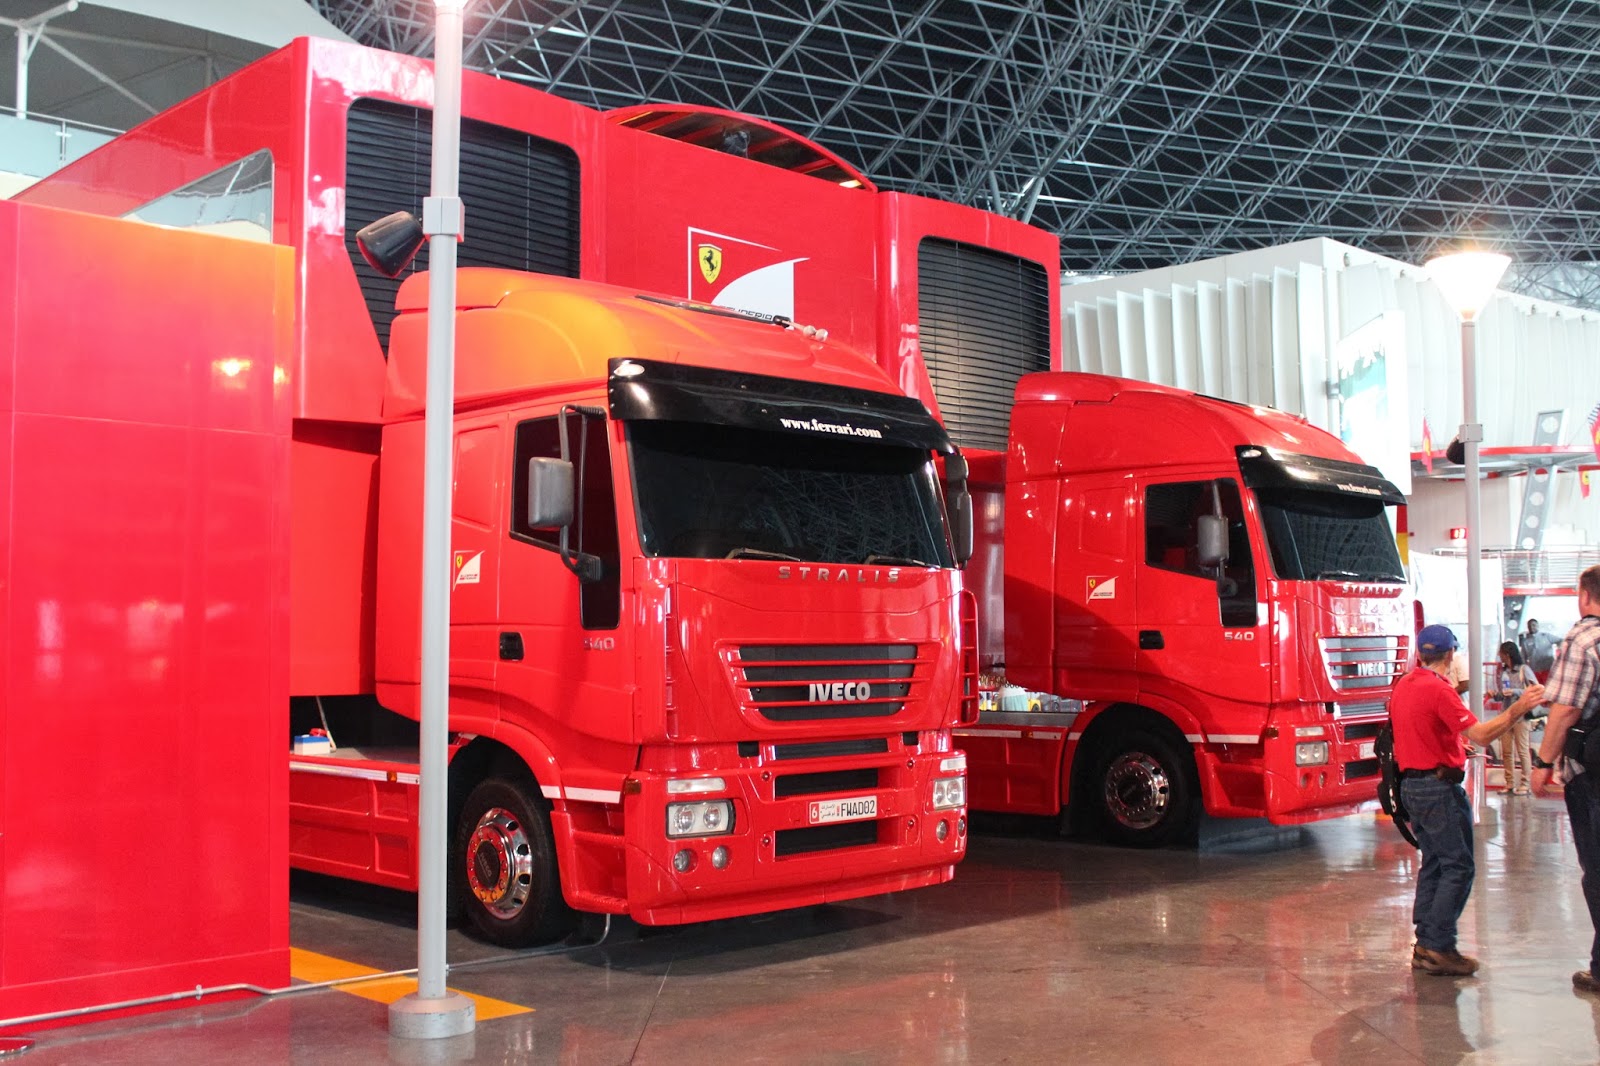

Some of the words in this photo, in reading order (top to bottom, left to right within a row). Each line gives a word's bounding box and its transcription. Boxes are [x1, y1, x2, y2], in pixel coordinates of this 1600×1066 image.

[780, 418, 882, 438] www.ferrari.com
[778, 565, 902, 583] STRALIS
[1224, 631, 1255, 641] 540
[1357, 662, 1386, 676] IVECO
[808, 681, 871, 703] IVECO
[811, 806, 819, 819] 6
